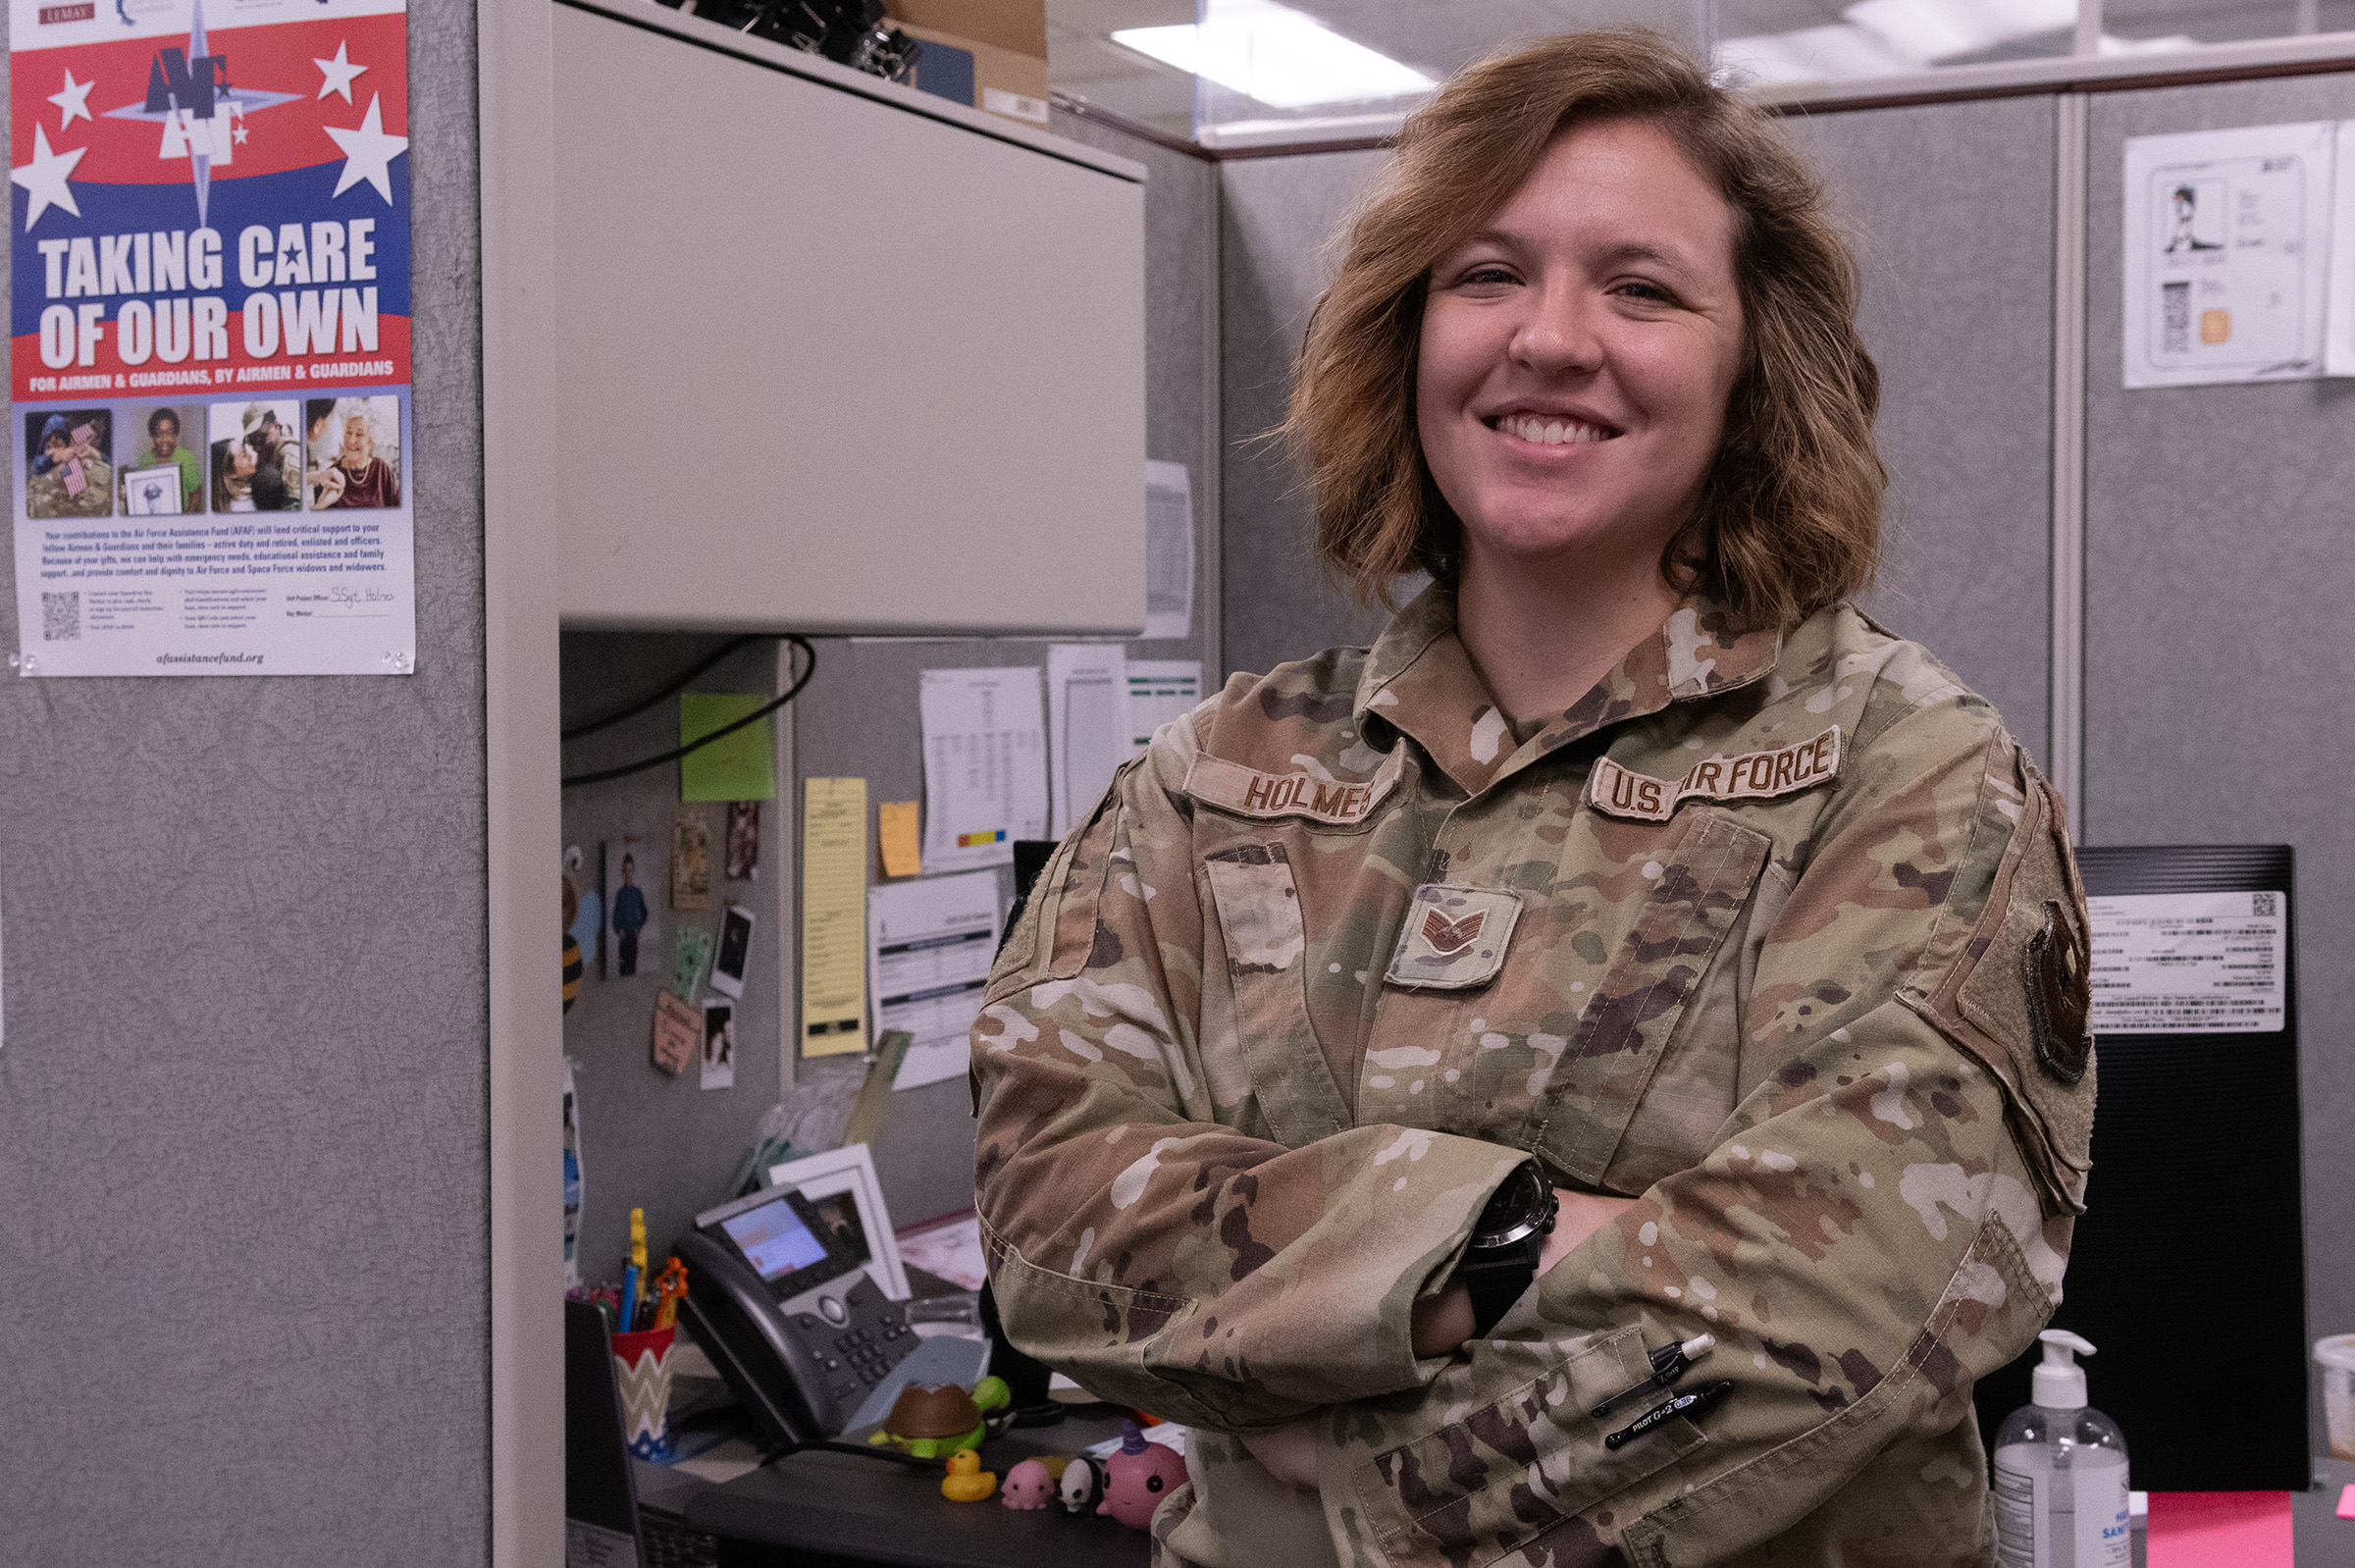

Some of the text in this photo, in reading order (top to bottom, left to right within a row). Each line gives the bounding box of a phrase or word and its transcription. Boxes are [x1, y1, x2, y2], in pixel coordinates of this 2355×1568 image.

[37, 218, 377, 298] TAKING CARE
[39, 287, 379, 369] OF OUR OWN
[29, 359, 393, 392] FOR AIRMEN & GUARDIANS, BY AIRMEN & GUARDIANS
[45, 532, 61, 541] Your
[63, 530, 110, 540] contributions
[120, 530, 131, 539] the
[133, 529, 144, 539] Air
[146, 529, 167, 538] Force
[169, 528, 209, 538] Assistance
[211, 527, 229, 537] Fund
[257, 526, 272, 536] will
[292, 525, 320, 535] critical
[322, 524, 351, 536] support
[362, 526, 380, 535] your
[42, 544, 66, 552] fellow
[67, 544, 93, 552] Airmen
[102, 542, 139, 551] Guardians
[141, 542, 155, 550] and
[156, 542, 174, 550] their
[175, 541, 206, 549] families
[214, 540, 236, 549] active
[237, 540, 254, 550] duty
[256, 540, 270, 549] and
[300, 538, 332, 548] enlisted
[334, 538, 348, 547] and
[41, 556, 73, 566] Because
[82, 558, 98, 567] your
[148, 554, 165, 565] help
[166, 554, 183, 563] with
[184, 555, 226, 564] emergency
[253, 551, 298, 561] educational
[300, 550, 341, 560] assistance
[343, 550, 358, 559] and
[359, 549, 385, 561] family
[86, 568, 114, 579] provide
[115, 567, 143, 576] comfort
[145, 567, 158, 576] and
[160, 566, 185, 578] dignity
[196, 566, 207, 575] Air
[209, 566, 230, 575] Force
[232, 565, 245, 574] and
[247, 565, 271, 576] Space
[273, 564, 294, 574] Force
[296, 564, 327, 573] widows
[328, 564, 343, 573] and
[156, 653, 264, 665] afassistancefund.org
[1611, 771, 1664, 814] U.S.
[1728, 734, 1830, 794] FORCE
[1632, 1417, 1652, 1433] PILOT
[1652, 1404, 1674, 1421] G-2
